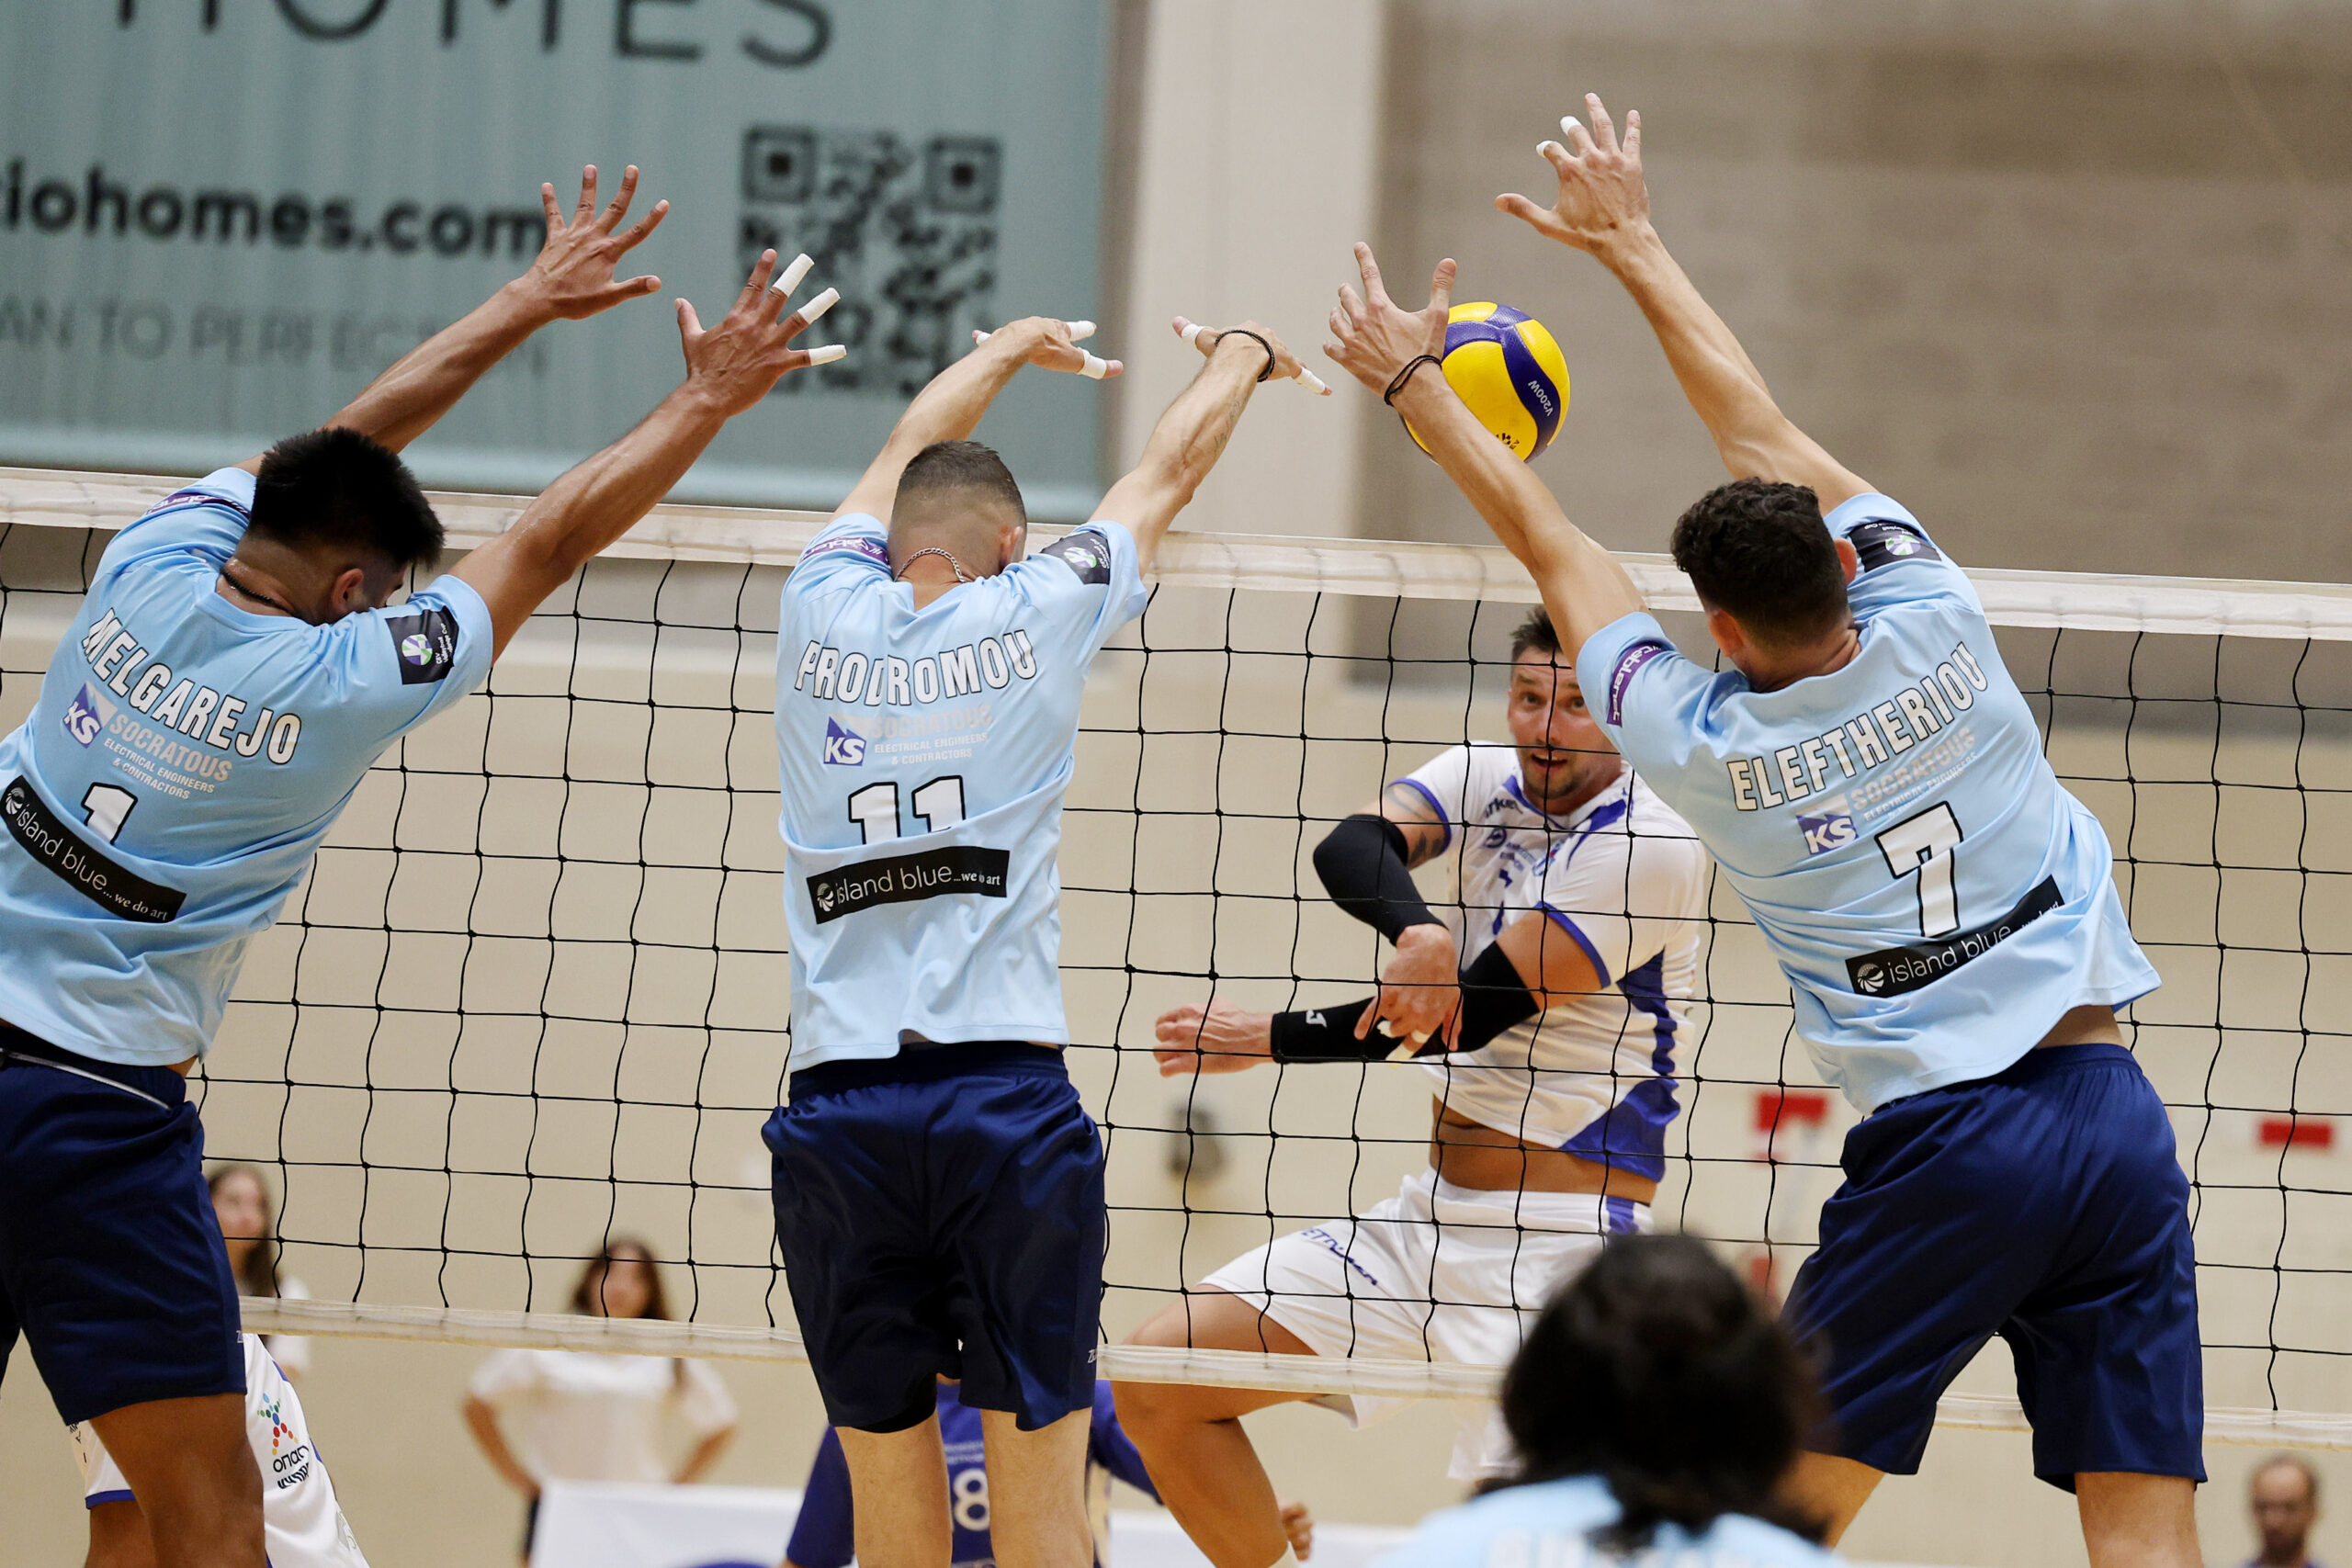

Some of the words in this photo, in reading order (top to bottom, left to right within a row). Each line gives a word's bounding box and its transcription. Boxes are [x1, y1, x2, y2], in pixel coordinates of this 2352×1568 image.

[0, 155, 549, 260] iohomes.com
[1528, 379, 1554, 416] V200W
[81, 607, 302, 765] MELGAREJO
[794, 628, 1037, 706] PRODROMOU
[63, 701, 100, 745] KS
[109, 714, 232, 782] SOCRATOUS
[824, 736, 865, 764] KS
[871, 704, 993, 739] SOCRATOUS
[875, 739, 932, 753] ELECTRICAL
[933, 732, 989, 748] ENGINEERS
[1726, 640, 1989, 812] ELEFTHERIOU
[104, 738, 155, 773] ELECTRICAL
[157, 767, 215, 794] ENGINEERS
[112, 758, 120, 767] &
[121, 761, 190, 800] CONTRACTORS
[901, 749, 973, 765] CONTRACTORS
[1850, 727, 1975, 810] SOCRATOUS
[81, 782, 138, 845] 1
[848, 774, 966, 845] 11
[1804, 817, 1857, 854] KS
[17, 804, 63, 857] island
[132, 901, 148, 914] do
[150, 909, 168, 920] art
[836, 869, 893, 905] island
[986, 874, 1001, 886] art
[1873, 800, 1964, 937] 7
[1887, 946, 1957, 984] island
[1961, 926, 2011, 959] blue
[953, 1469, 990, 1531] 8
